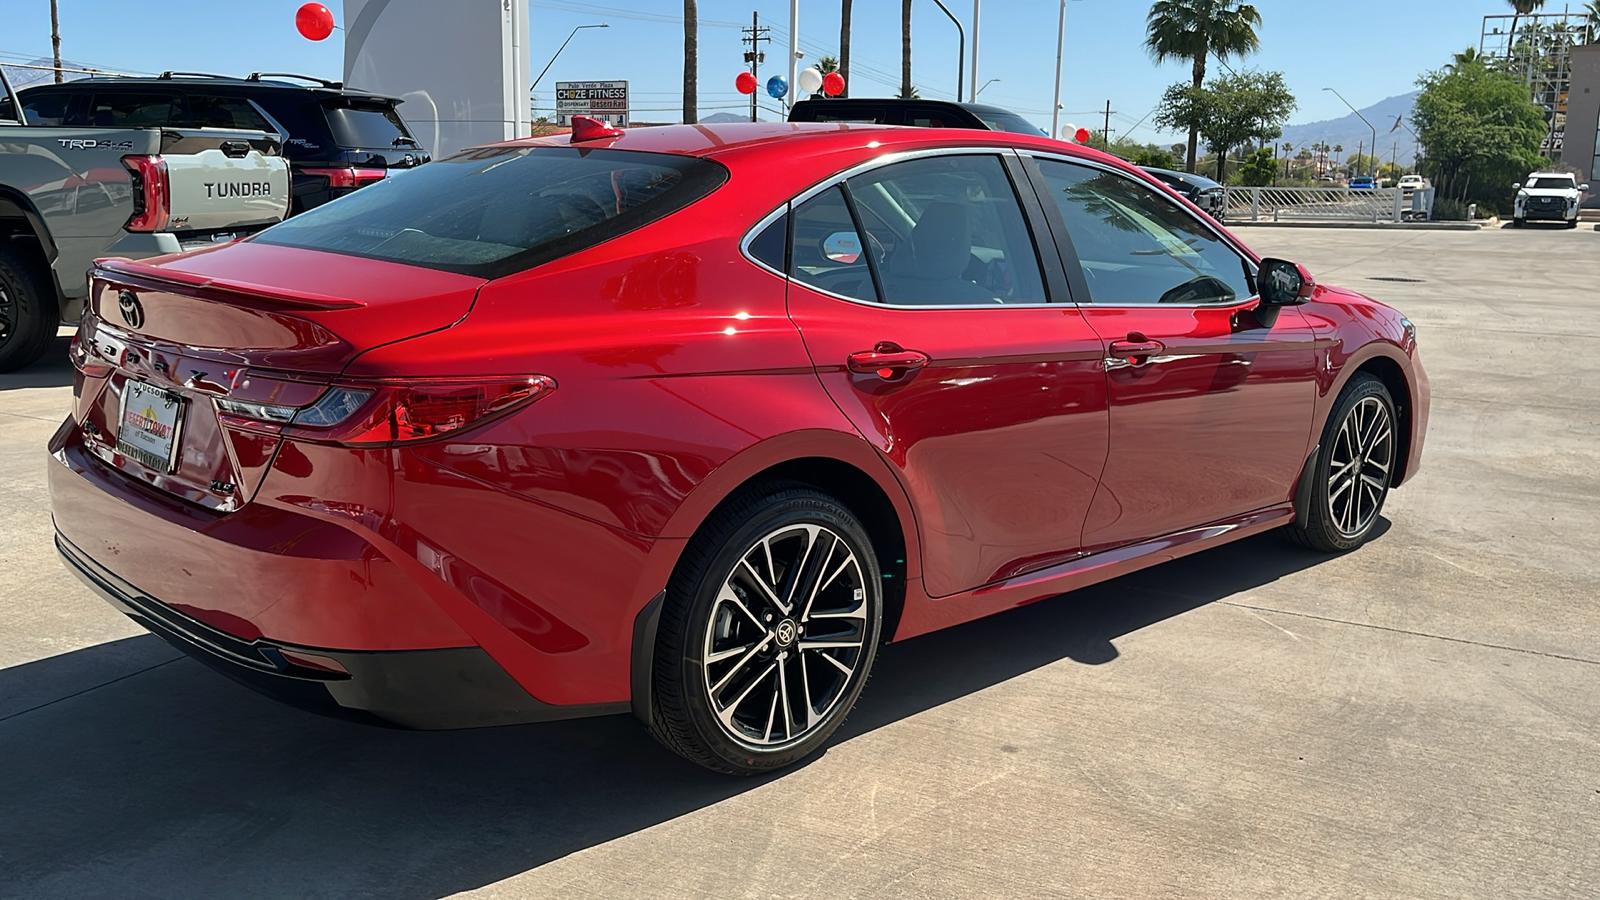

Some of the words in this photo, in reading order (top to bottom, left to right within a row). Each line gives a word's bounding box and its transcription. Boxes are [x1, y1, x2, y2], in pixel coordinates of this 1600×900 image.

[588, 89, 626, 99] FITNESS
[57, 139, 97, 149] TRD
[203, 182, 272, 199] TUNDRA
[140, 431, 156, 444] Tucson
